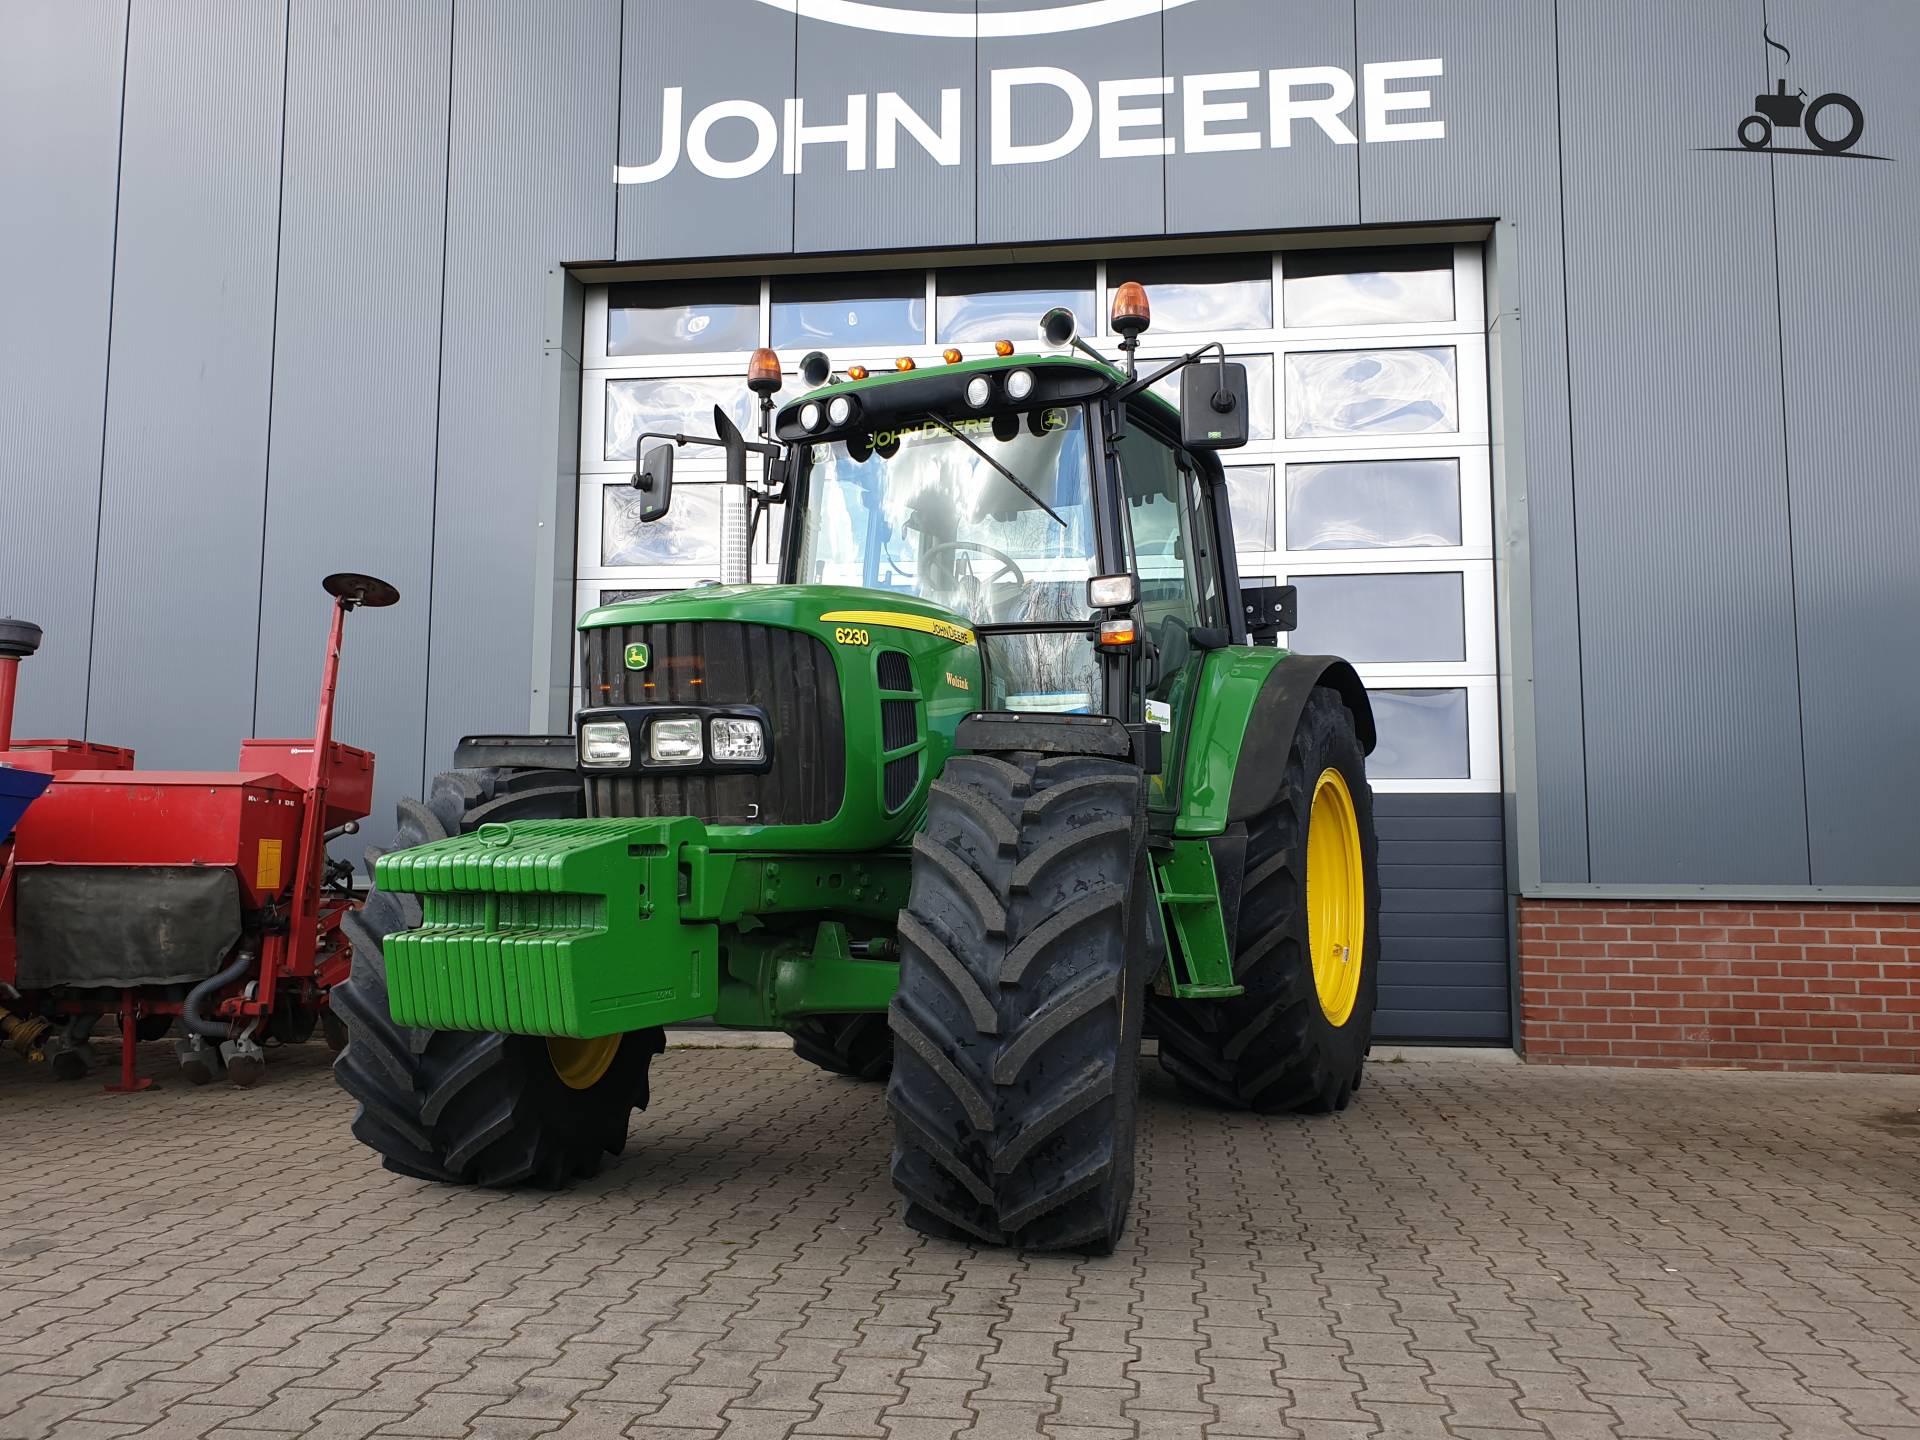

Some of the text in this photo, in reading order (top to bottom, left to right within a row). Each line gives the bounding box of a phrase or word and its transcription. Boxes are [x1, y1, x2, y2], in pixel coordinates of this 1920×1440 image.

[613, 57, 1446, 184] JOHN DEERE
[866, 427, 919, 449] JOHN
[835, 627, 869, 646] 6230
[932, 621, 969, 644] JOHN DEERE
